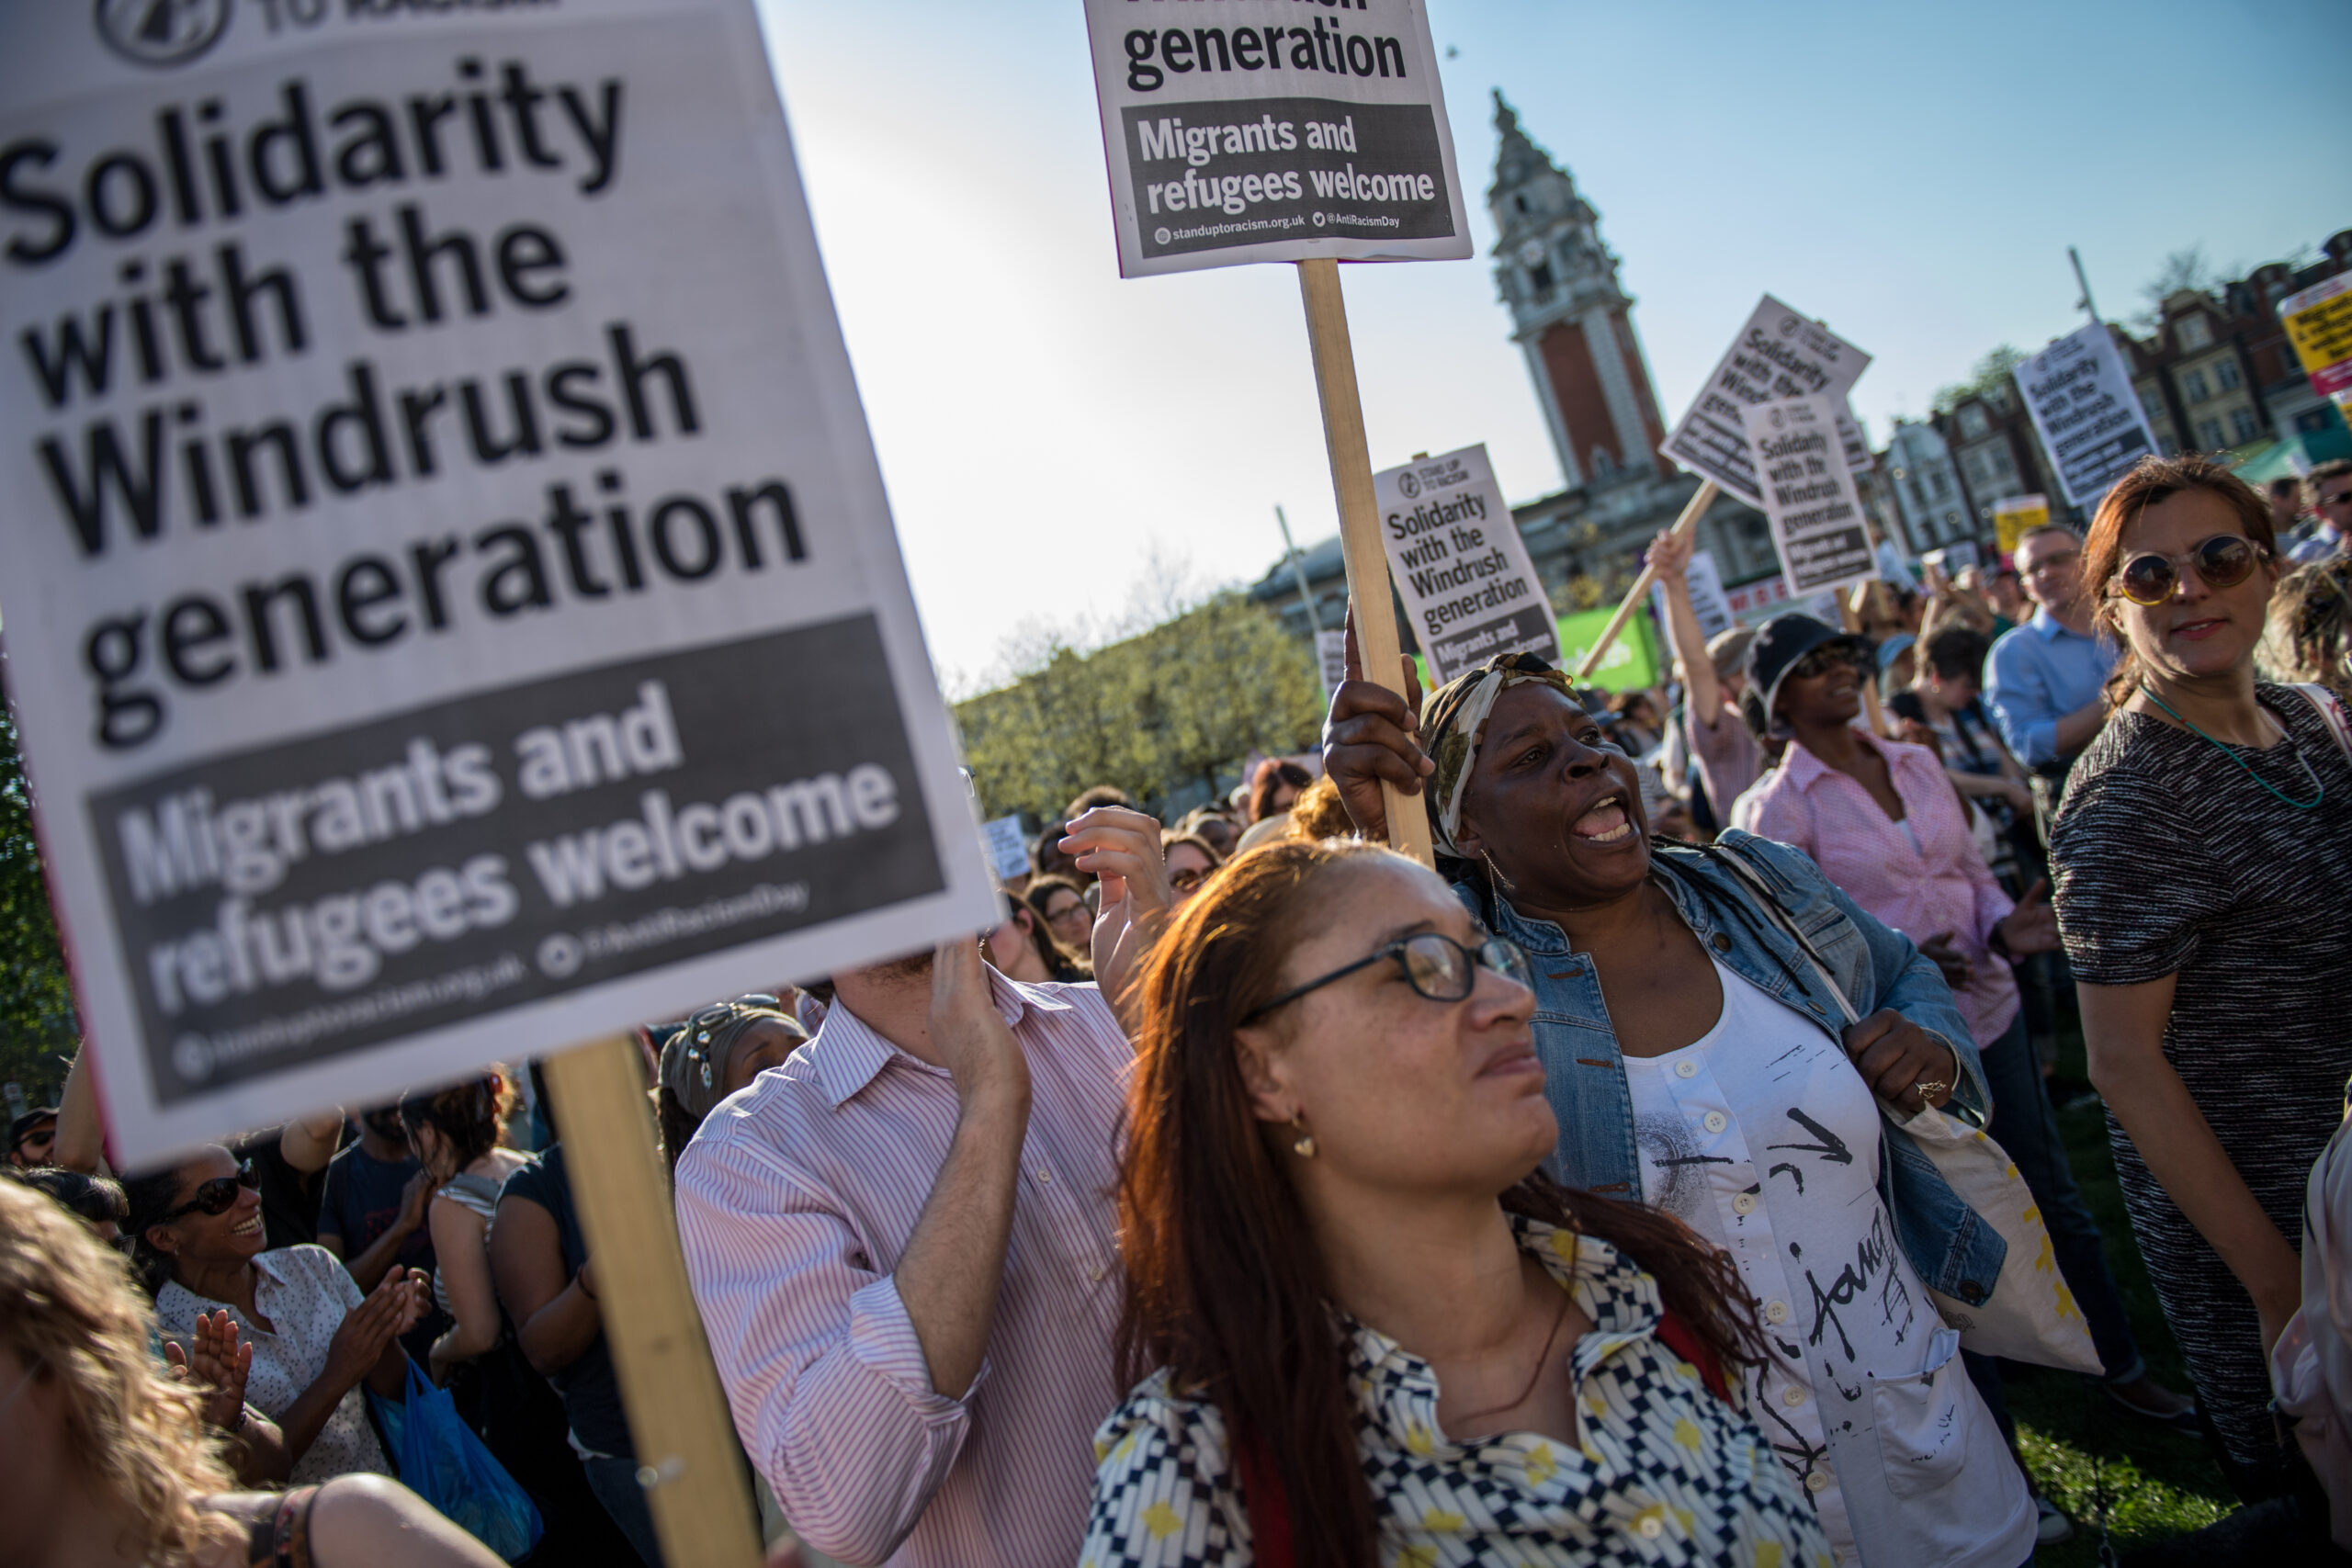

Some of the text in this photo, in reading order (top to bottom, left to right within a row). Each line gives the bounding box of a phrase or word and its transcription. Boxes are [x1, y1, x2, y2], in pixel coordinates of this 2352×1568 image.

[1124, 16, 1407, 92] generation
[0, 57, 624, 266] Solidarity
[1137, 114, 1358, 166] Migrants and
[1148, 163, 1435, 215] refugees welcome
[1172, 212, 1400, 241] standuptoracism.org.uk @AntiRacismDay
[18, 201, 575, 412] with the
[35, 320, 704, 558] Windrush
[1387, 492, 1487, 540] Solidarity
[1399, 525, 1485, 570] with the
[1408, 547, 1510, 600] Windrush
[83, 468, 810, 749] generation
[1423, 575, 1529, 636] generation
[1436, 618, 1520, 665] Migrants and
[115, 682, 682, 906] Migrants and
[148, 763, 899, 1016] refugees welcome
